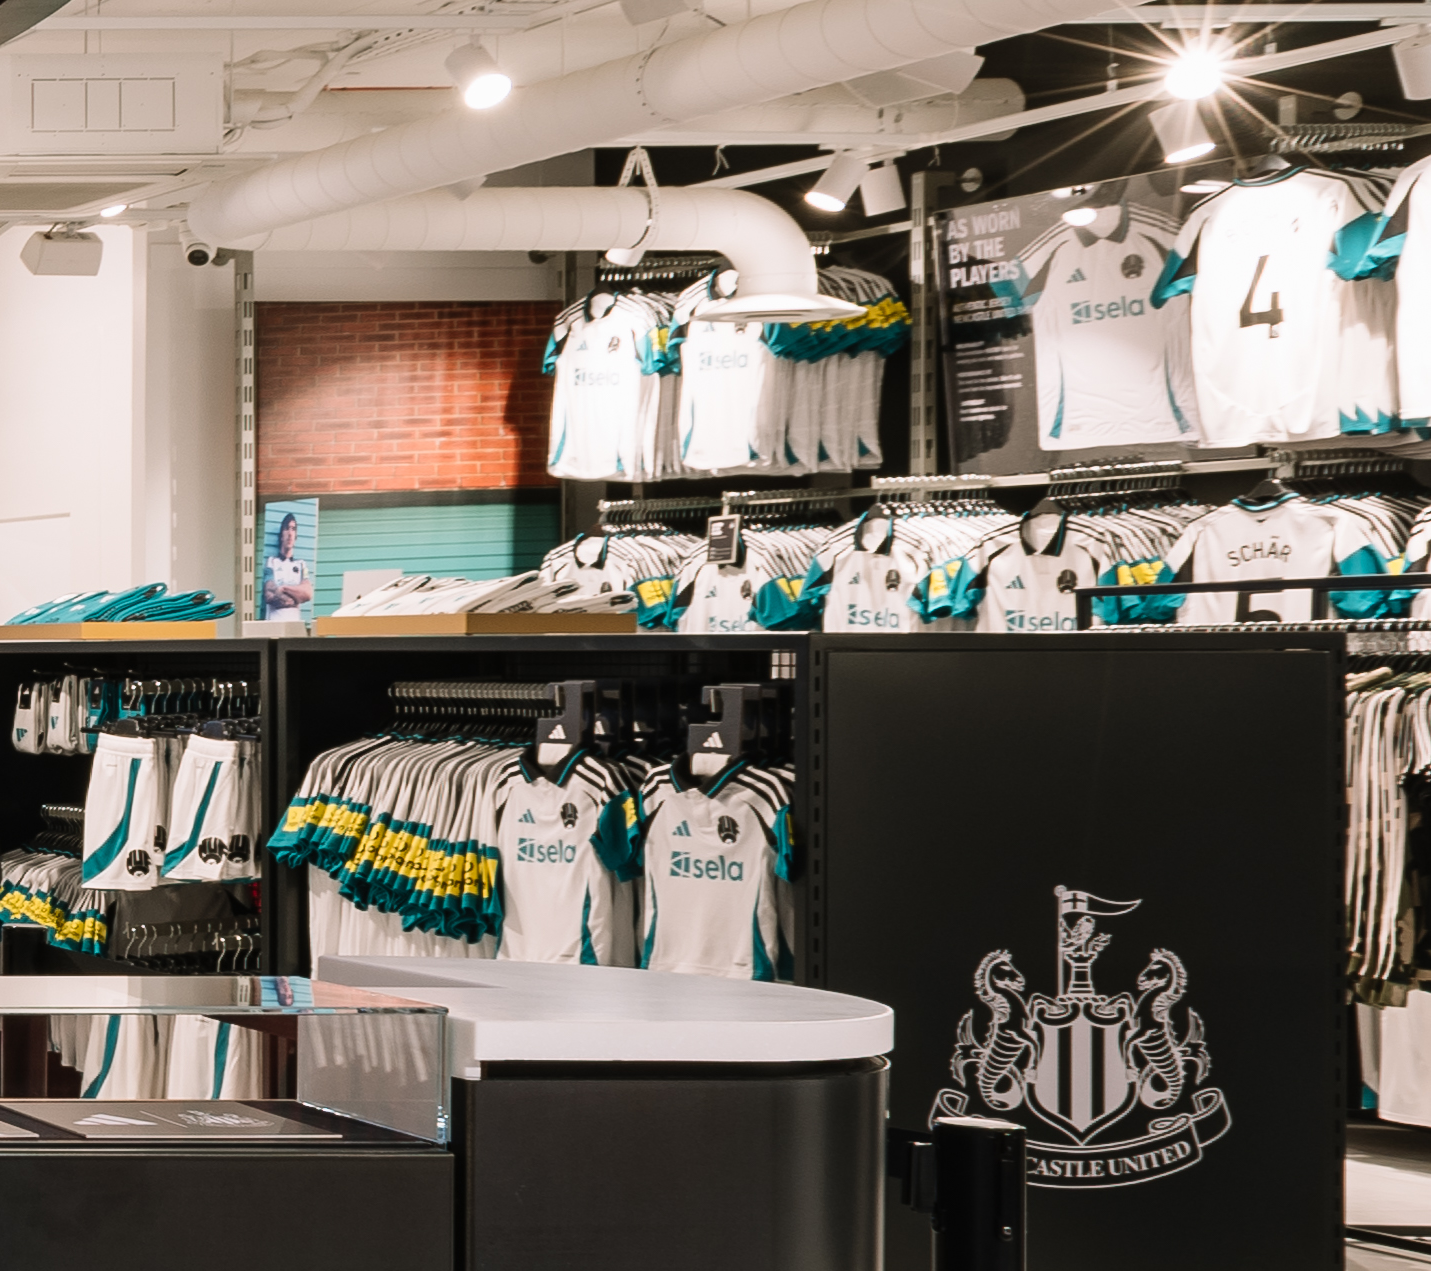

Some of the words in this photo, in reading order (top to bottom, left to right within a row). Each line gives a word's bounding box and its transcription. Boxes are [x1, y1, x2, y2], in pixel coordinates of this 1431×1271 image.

[946, 218, 968, 240] AS
[971, 207, 1021, 234] WORN
[949, 242, 970, 264] BY
[973, 236, 1005, 259] THE
[950, 260, 1020, 289] PLAYERS
[1094, 296, 1145, 320] sela
[1238, 254, 1283, 339] 4
[859, 607, 899, 628] sela
[537, 839, 576, 864] sela
[693, 855, 744, 881] sela
[1026, 1157, 1105, 1178] CASTLE
[1107, 1140, 1191, 1177] UNITED
